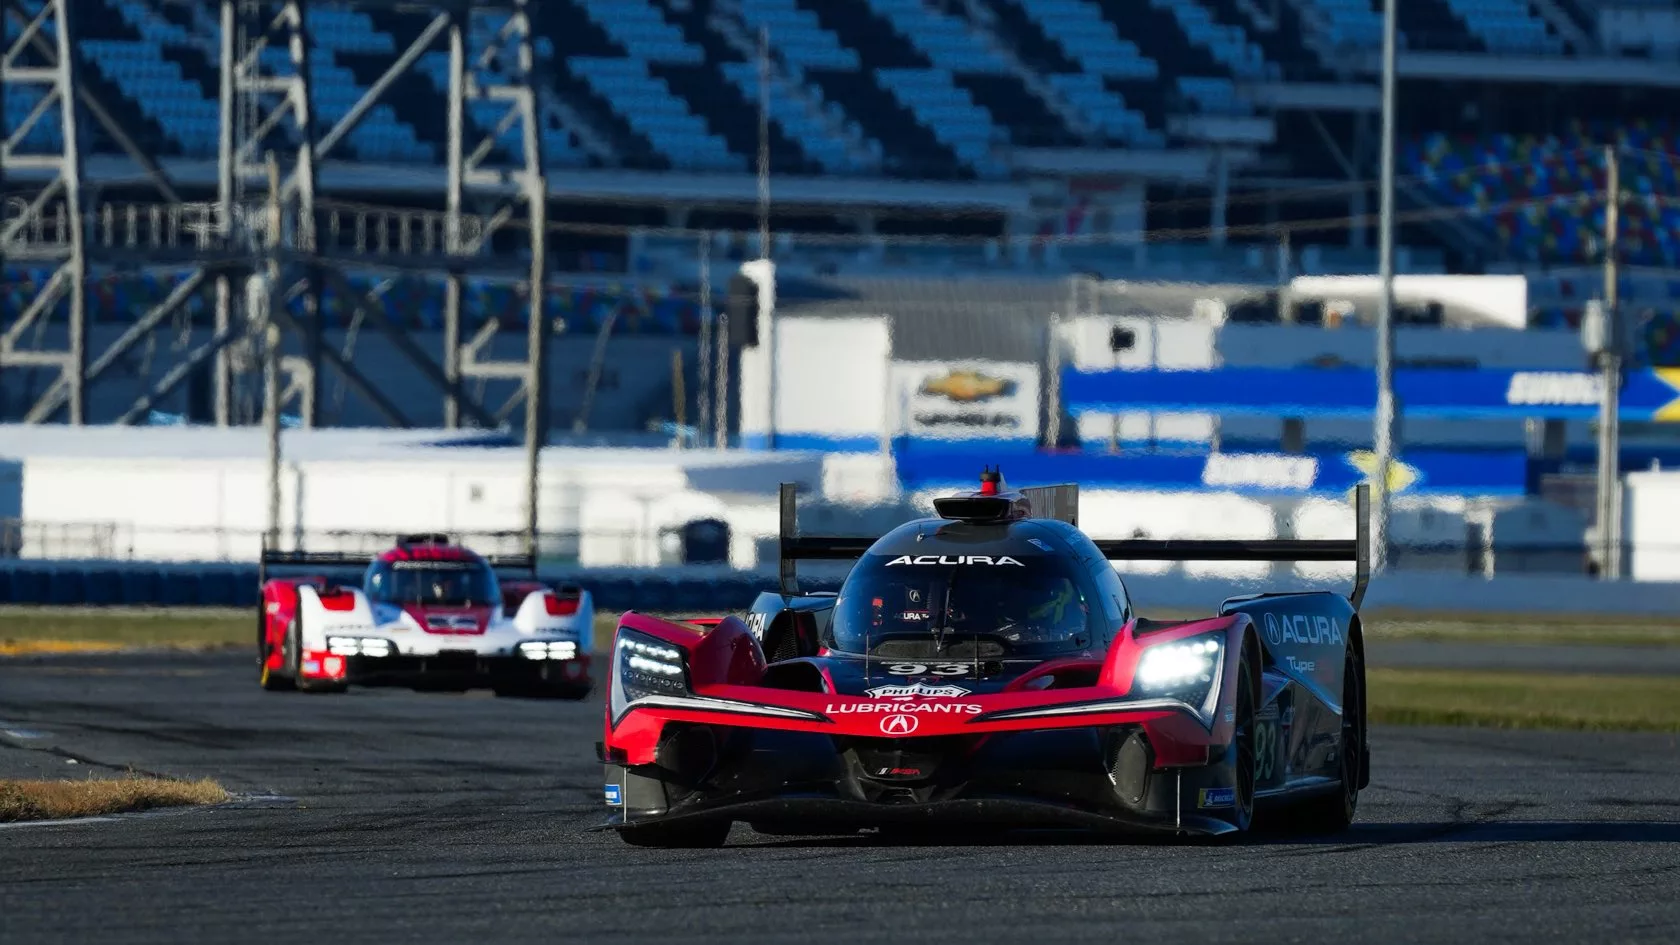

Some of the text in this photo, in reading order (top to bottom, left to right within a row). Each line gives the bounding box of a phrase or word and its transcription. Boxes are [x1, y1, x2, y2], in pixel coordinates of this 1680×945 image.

[884, 555, 1026, 567] ACURA
[1282, 614, 1345, 646] ACURA
[887, 663, 970, 676] 93
[1285, 656, 1316, 673] Type
[882, 687, 954, 696] PHILLIPS
[825, 702, 983, 714] LUBRICANTS
[1254, 721, 1277, 780] 93
